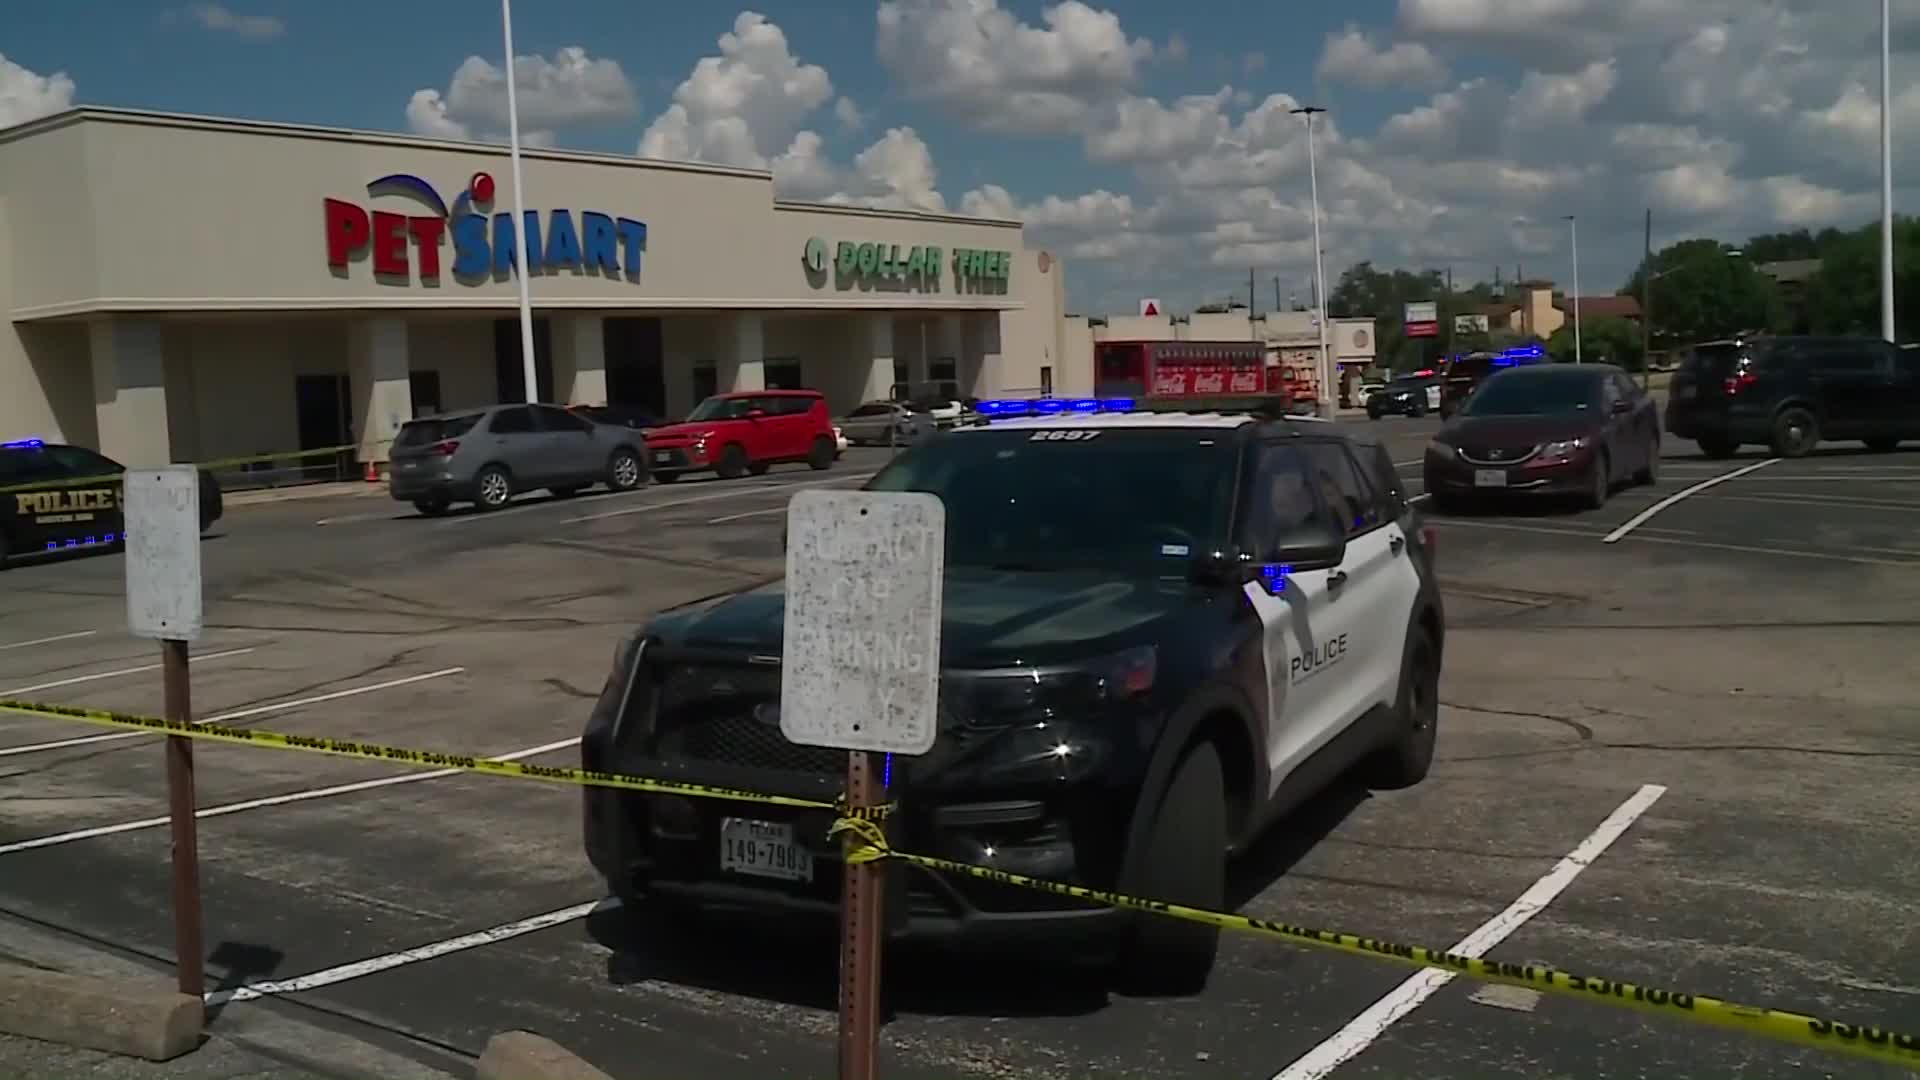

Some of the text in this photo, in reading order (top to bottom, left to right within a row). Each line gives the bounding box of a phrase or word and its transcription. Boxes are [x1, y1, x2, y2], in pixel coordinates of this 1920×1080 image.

[837, 240, 1012, 282] DOLLAR TREE
[1030, 430, 1103, 441] 2697
[16, 489, 113, 514] POLICE
[1291, 632, 1348, 680] POLICE
